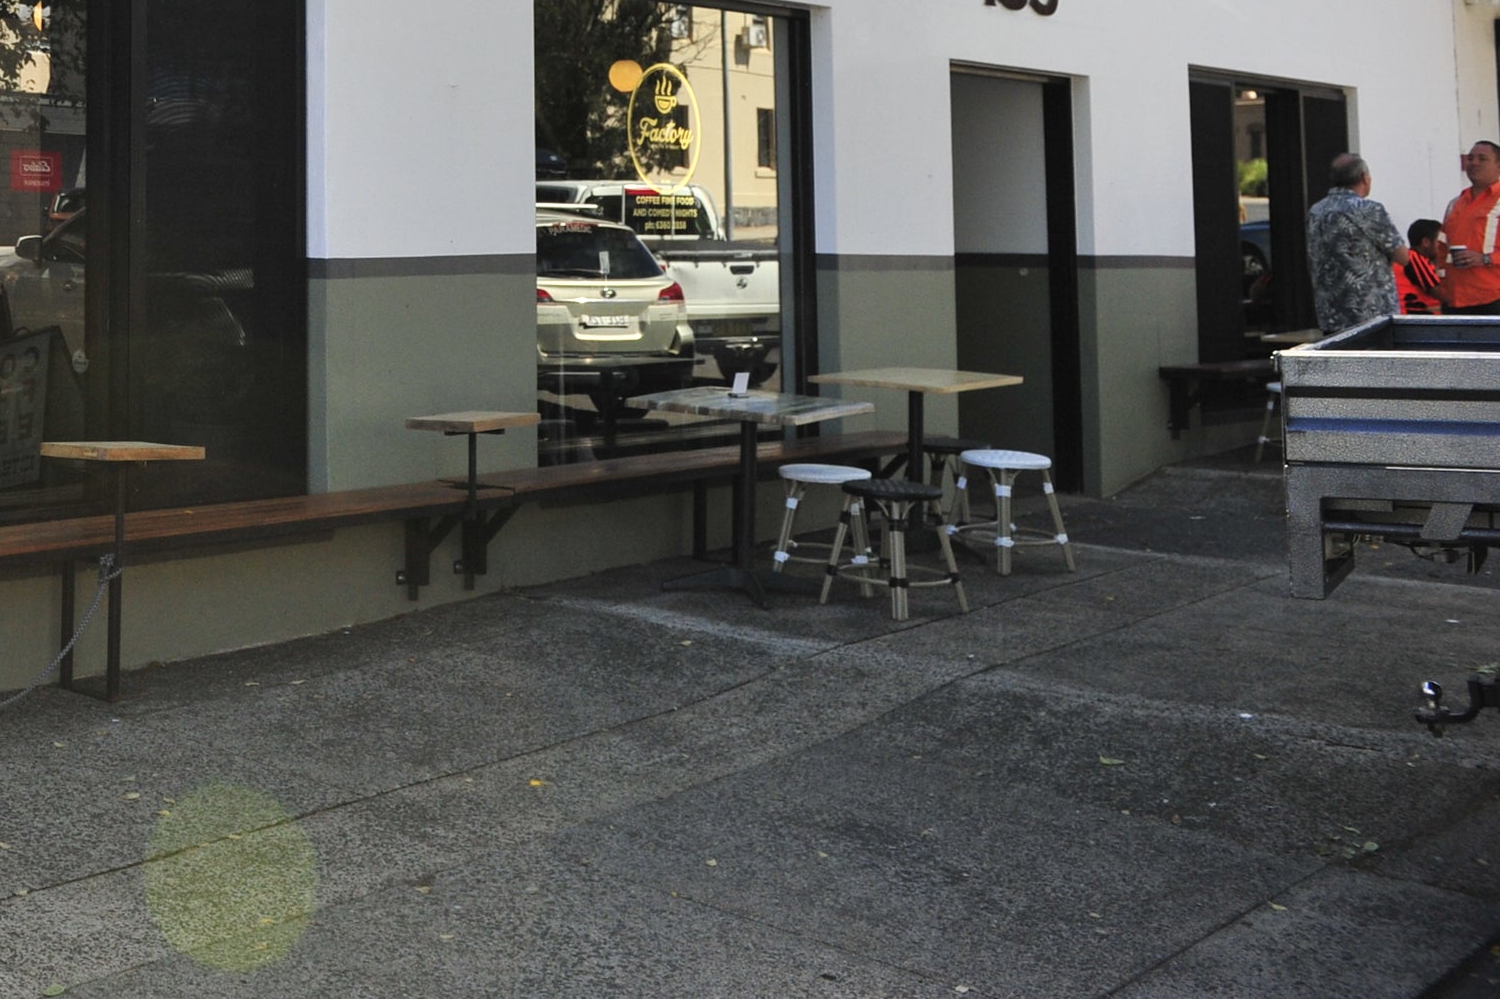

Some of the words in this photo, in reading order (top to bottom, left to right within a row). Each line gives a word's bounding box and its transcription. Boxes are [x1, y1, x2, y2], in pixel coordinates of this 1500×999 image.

[637, 117, 694, 150] Factory
[635, 195, 661, 205] COFFEE
[633, 208, 647, 217] AND
